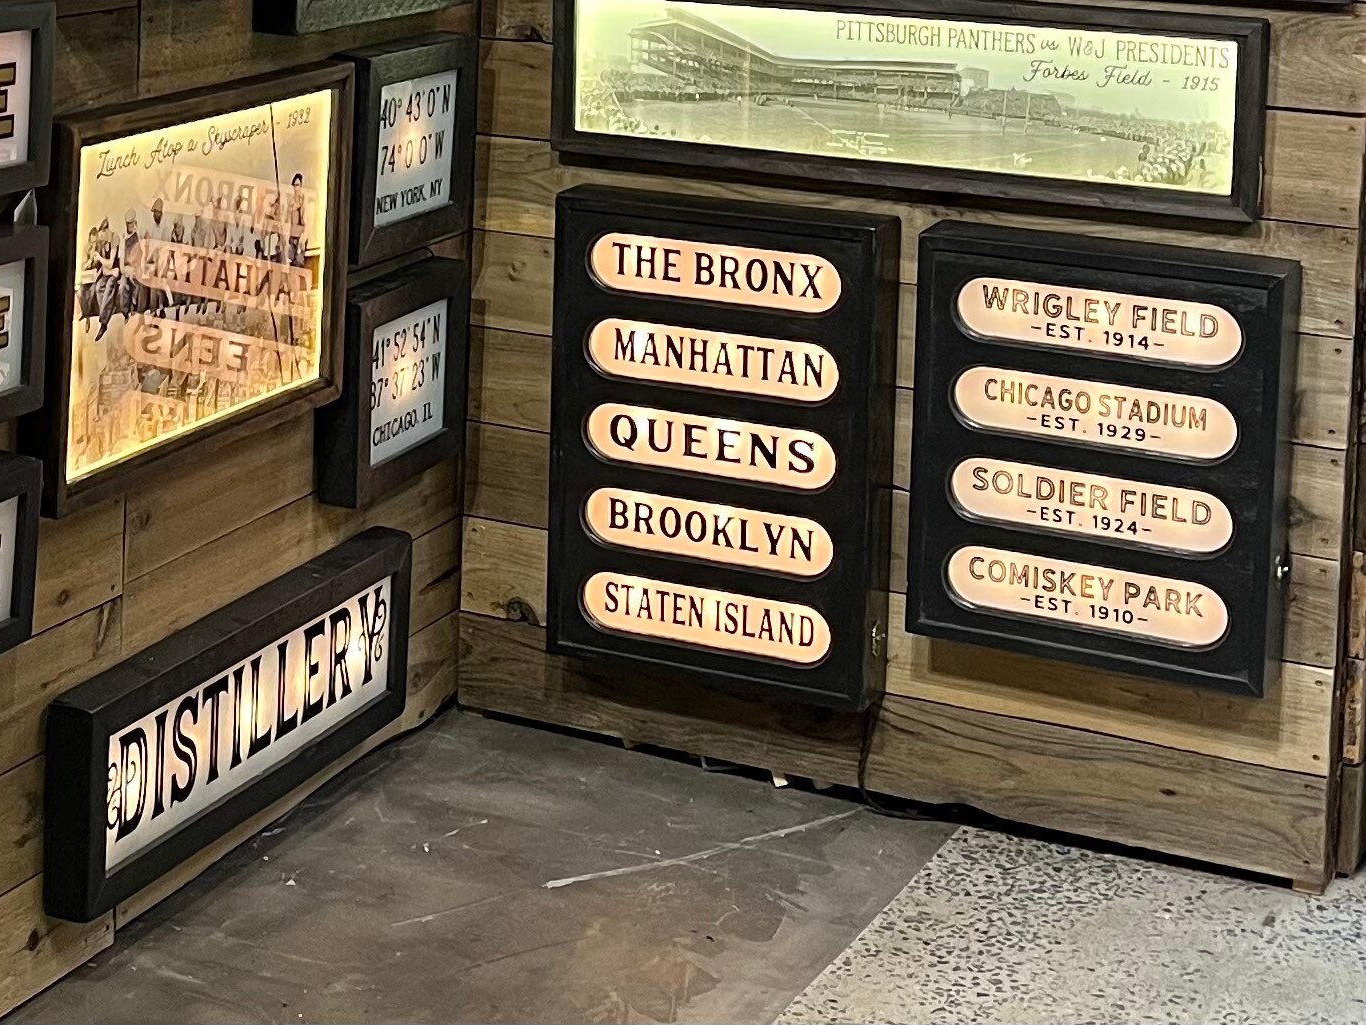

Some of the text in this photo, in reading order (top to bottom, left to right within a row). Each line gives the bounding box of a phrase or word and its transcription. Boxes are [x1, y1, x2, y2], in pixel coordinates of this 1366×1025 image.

[836, 19, 942, 48] PITTSBURGH
[948, 26, 1036, 55] PANTHERS
[1068, 36, 1106, 59] W&J
[1116, 39, 1230, 69] PRESIDENTS
[442, 84, 451, 114] N
[1023, 59, 1221, 92] Forbes Field 1915
[97, 147, 141, 180] Lunch
[144, 137, 183, 170] Atop
[202, 118, 270, 156] Skyscraper
[434, 129, 445, 160] W
[376, 189, 397, 216] NEW
[429, 178, 443, 199] NY
[612, 241, 824, 299] THE BRONX
[432, 313, 441, 345] N
[982, 284, 1220, 339] WRIGLEY FIELD
[431, 351, 441, 382] W
[613, 327, 825, 389] MANHATTAN
[423, 401, 433, 423] IL
[984, 378, 1207, 431] CHICAGO STADIUM
[609, 413, 816, 474] QUEENS
[971, 466, 1212, 525] SOLDIER FIELD
[608, 496, 814, 562] BROOKLYN
[604, 581, 815, 647] STATEN ISLAND
[968, 556, 1204, 618] COMISKEY PARK
[112, 584, 386, 843] DISTILLERY
